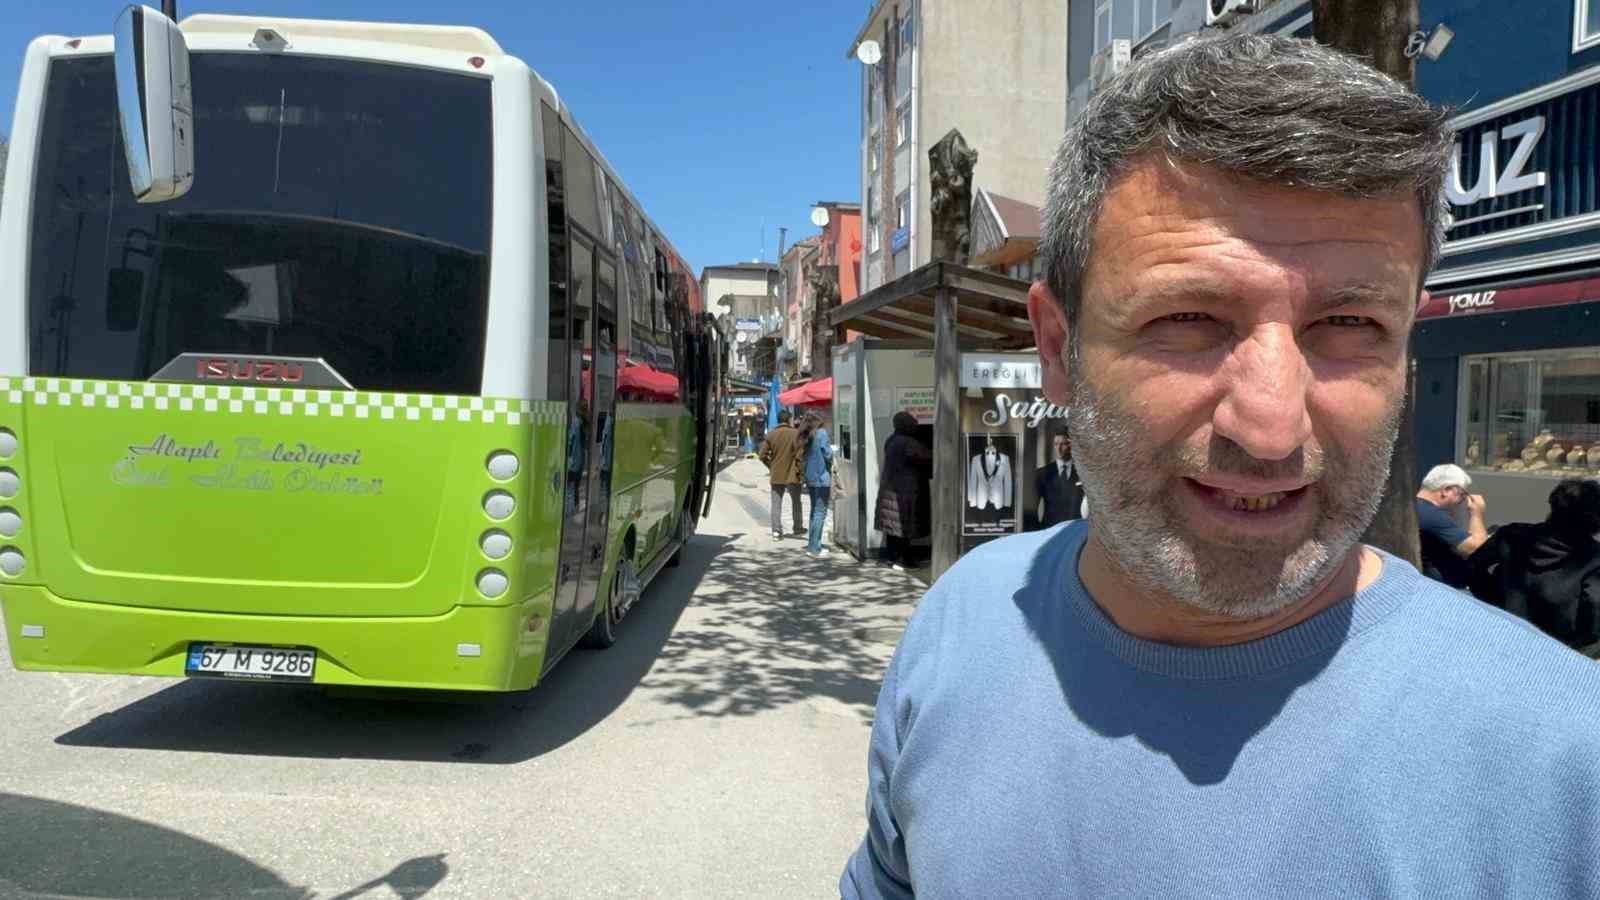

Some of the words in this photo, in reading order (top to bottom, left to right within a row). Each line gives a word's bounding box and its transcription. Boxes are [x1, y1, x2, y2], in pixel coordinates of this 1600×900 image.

[196, 360, 304, 382] ISUZU
[127, 433, 220, 464] Alaplı
[200, 647, 227, 669] 67
[233, 650, 253, 671] M
[261, 651, 311, 673] 9286
